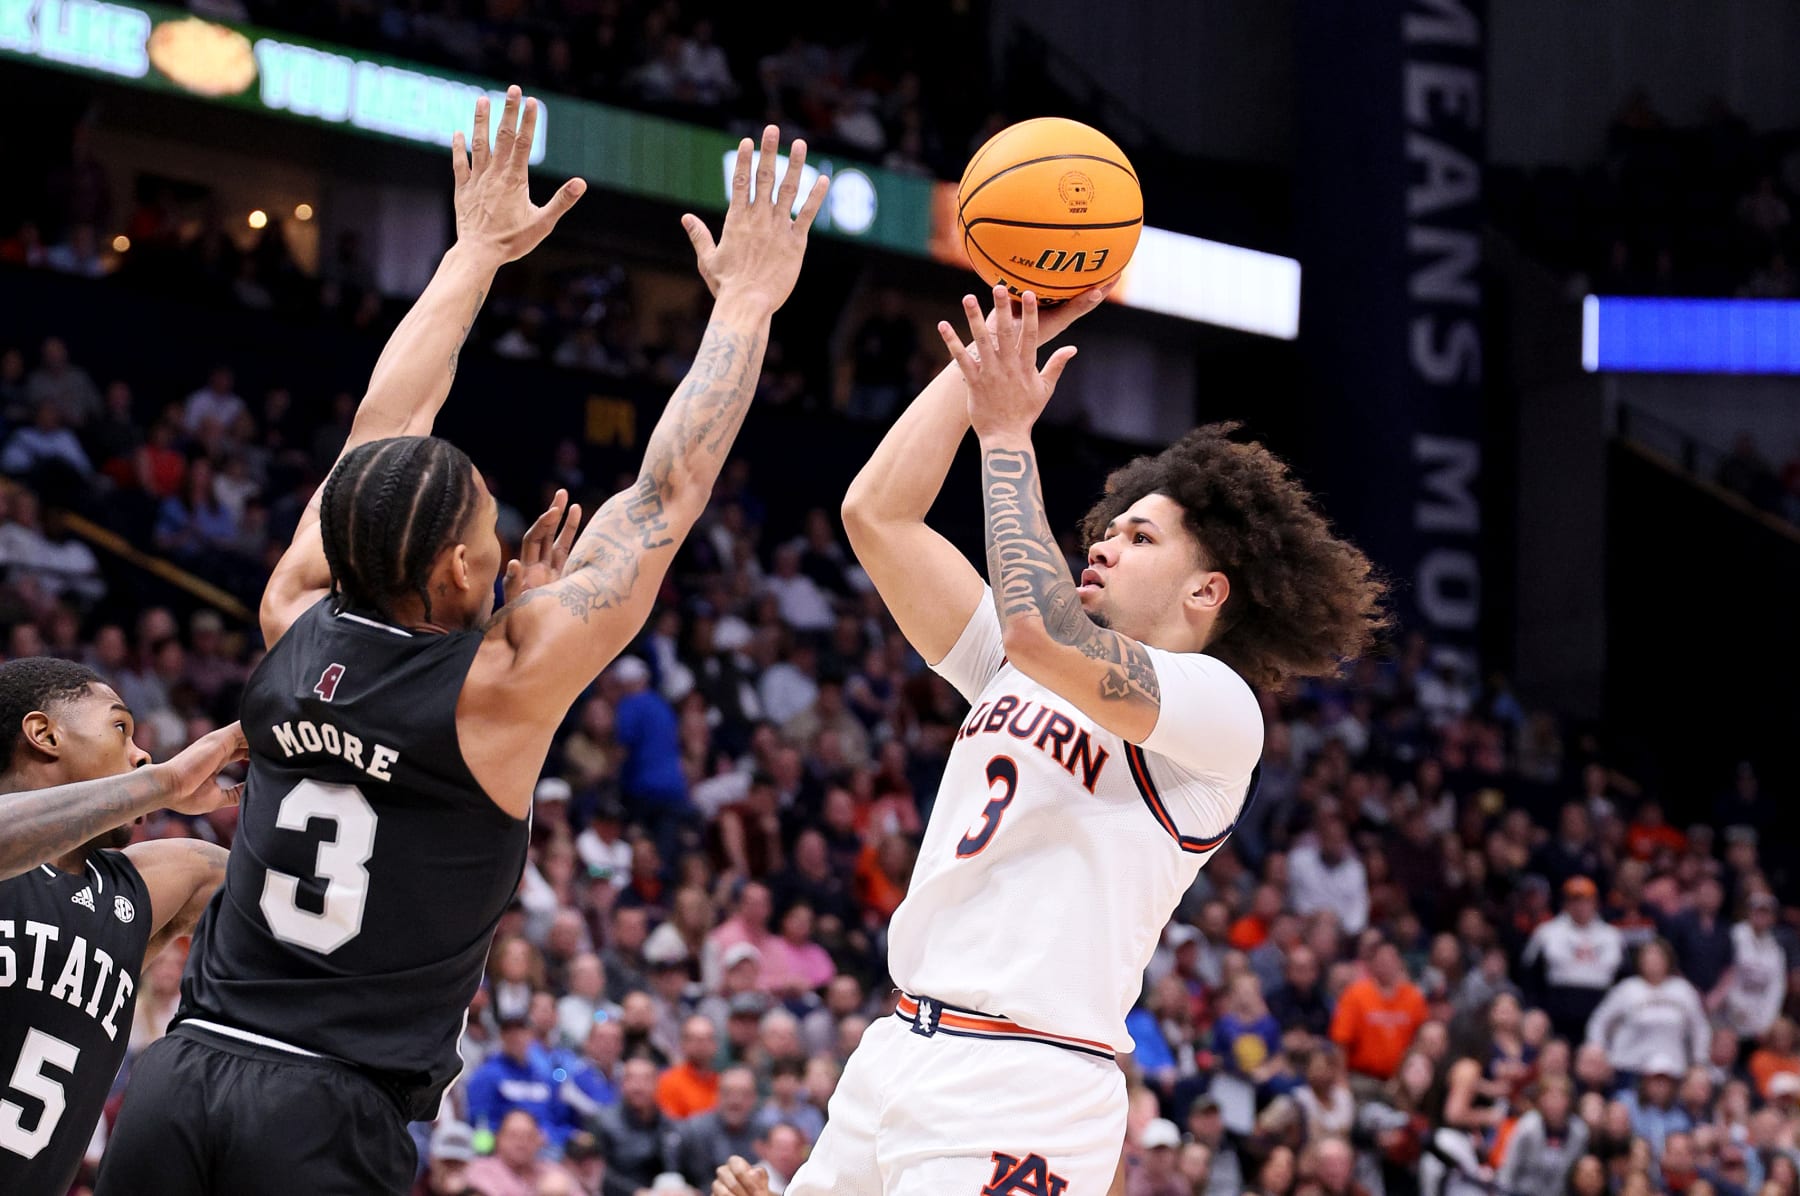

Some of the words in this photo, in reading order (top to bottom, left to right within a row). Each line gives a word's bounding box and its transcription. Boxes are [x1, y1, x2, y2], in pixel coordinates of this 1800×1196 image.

[1009, 255, 1035, 268] NXT
[1034, 248, 1110, 273] EVO
[272, 720, 399, 782] MOORE
[957, 694, 1110, 795] UBURN
[955, 754, 1019, 859] 3
[260, 778, 378, 955] 3
[114, 896, 135, 922] SEC
[0, 1026, 81, 1160] 5
